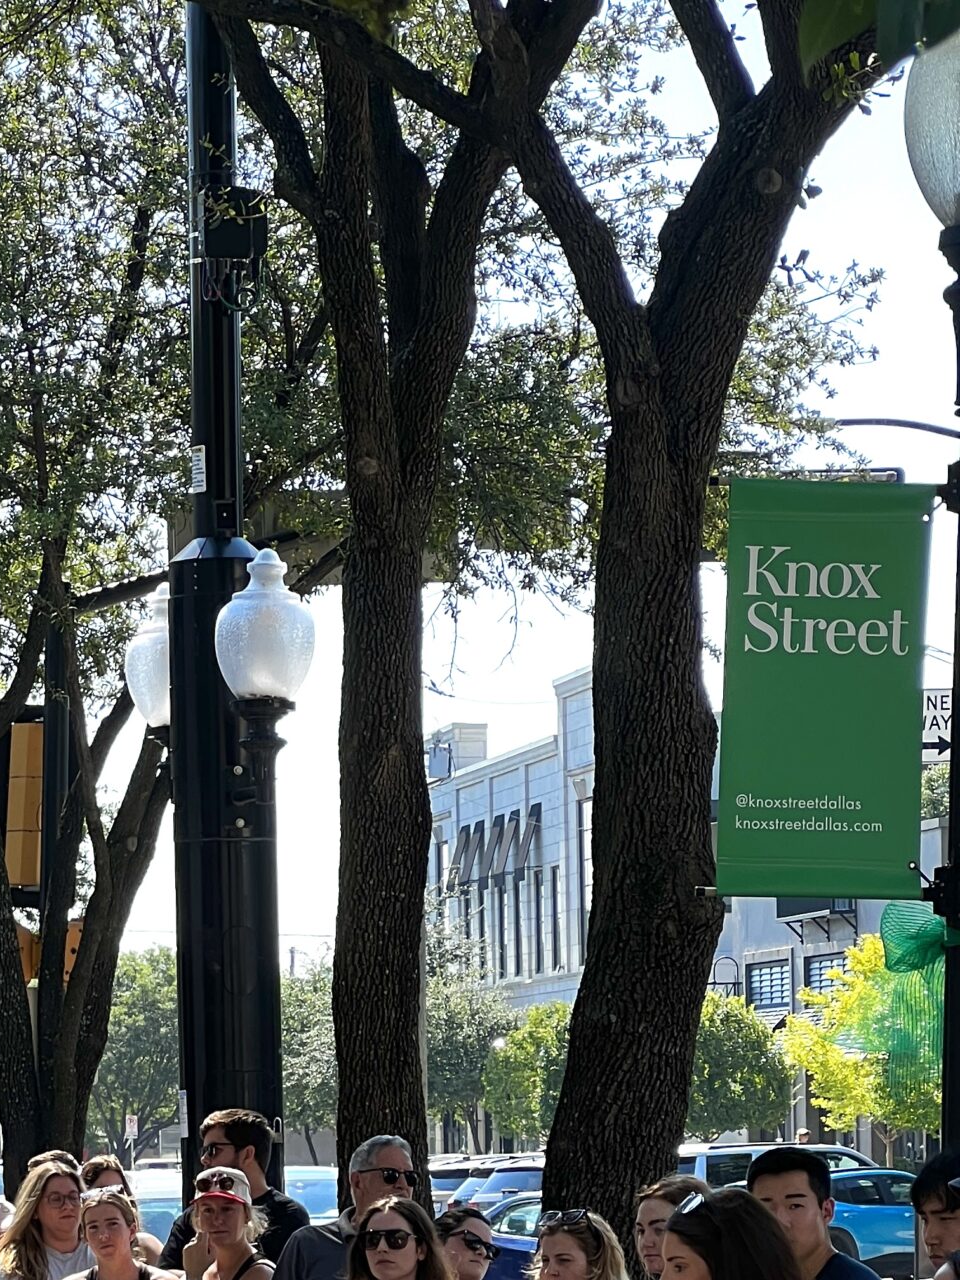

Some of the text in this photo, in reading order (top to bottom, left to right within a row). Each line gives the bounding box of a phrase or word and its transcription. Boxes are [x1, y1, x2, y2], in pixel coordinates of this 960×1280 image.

[743, 545, 882, 598] Knox
[744, 601, 909, 657] Street
[926, 695, 951, 711] NE
[923, 714, 952, 731] AY
[735, 792, 862, 811] @knoxstreetdallas
[735, 814, 883, 833] knoxstreetdallas.com
